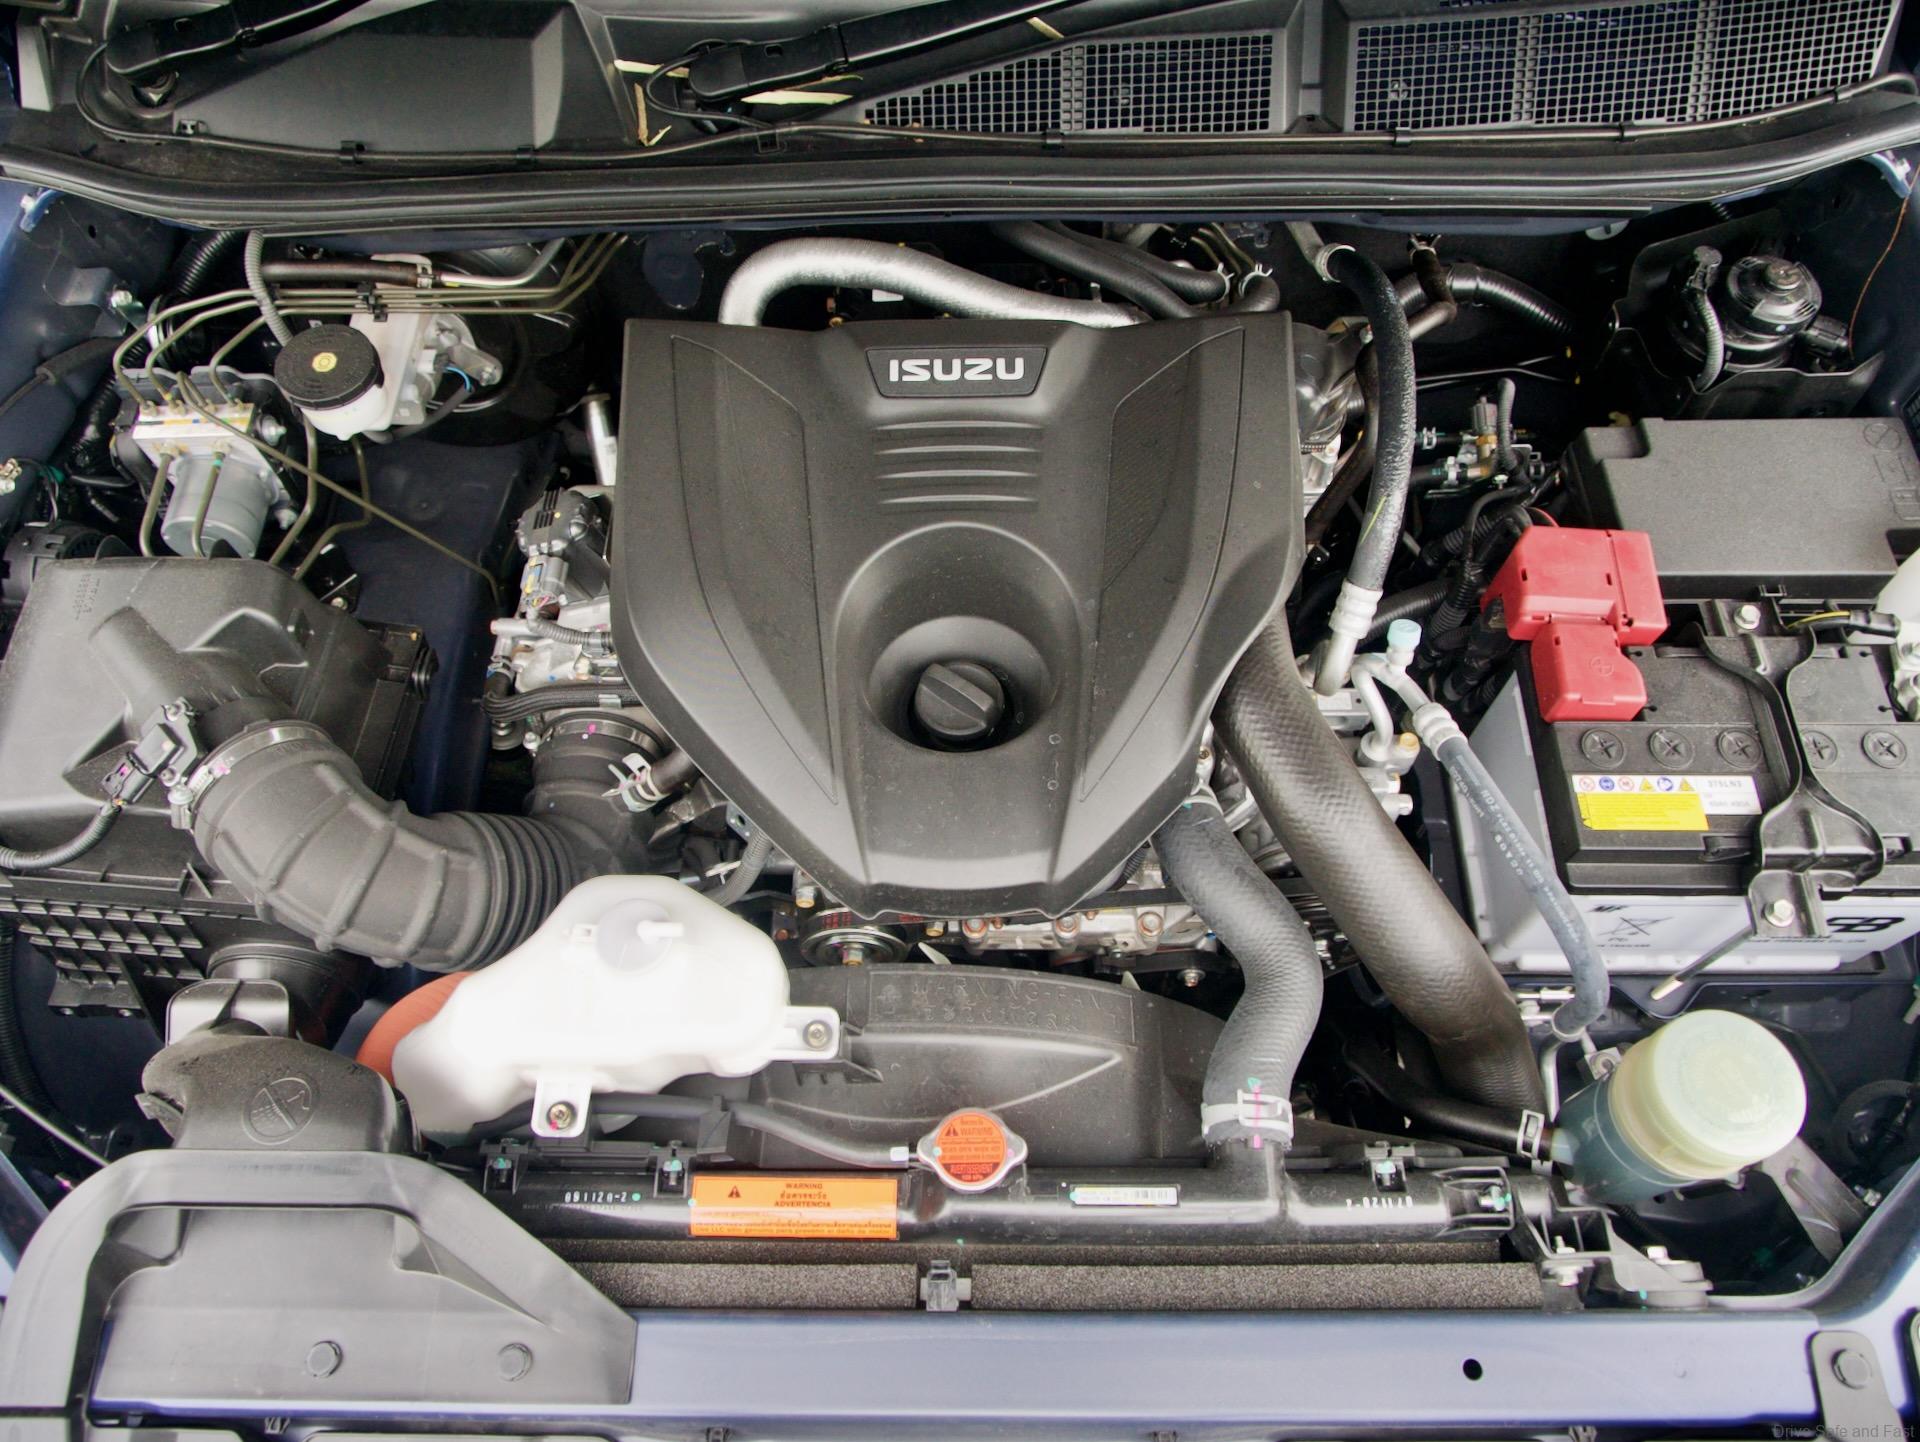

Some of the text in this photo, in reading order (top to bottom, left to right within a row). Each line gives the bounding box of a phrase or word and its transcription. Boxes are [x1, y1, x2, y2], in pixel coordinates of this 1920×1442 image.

[889, 357, 1024, 382] ISUZU
[960, 1127, 993, 1137] WARNING
[774, 1200, 831, 1208] ADVERTENCIA
